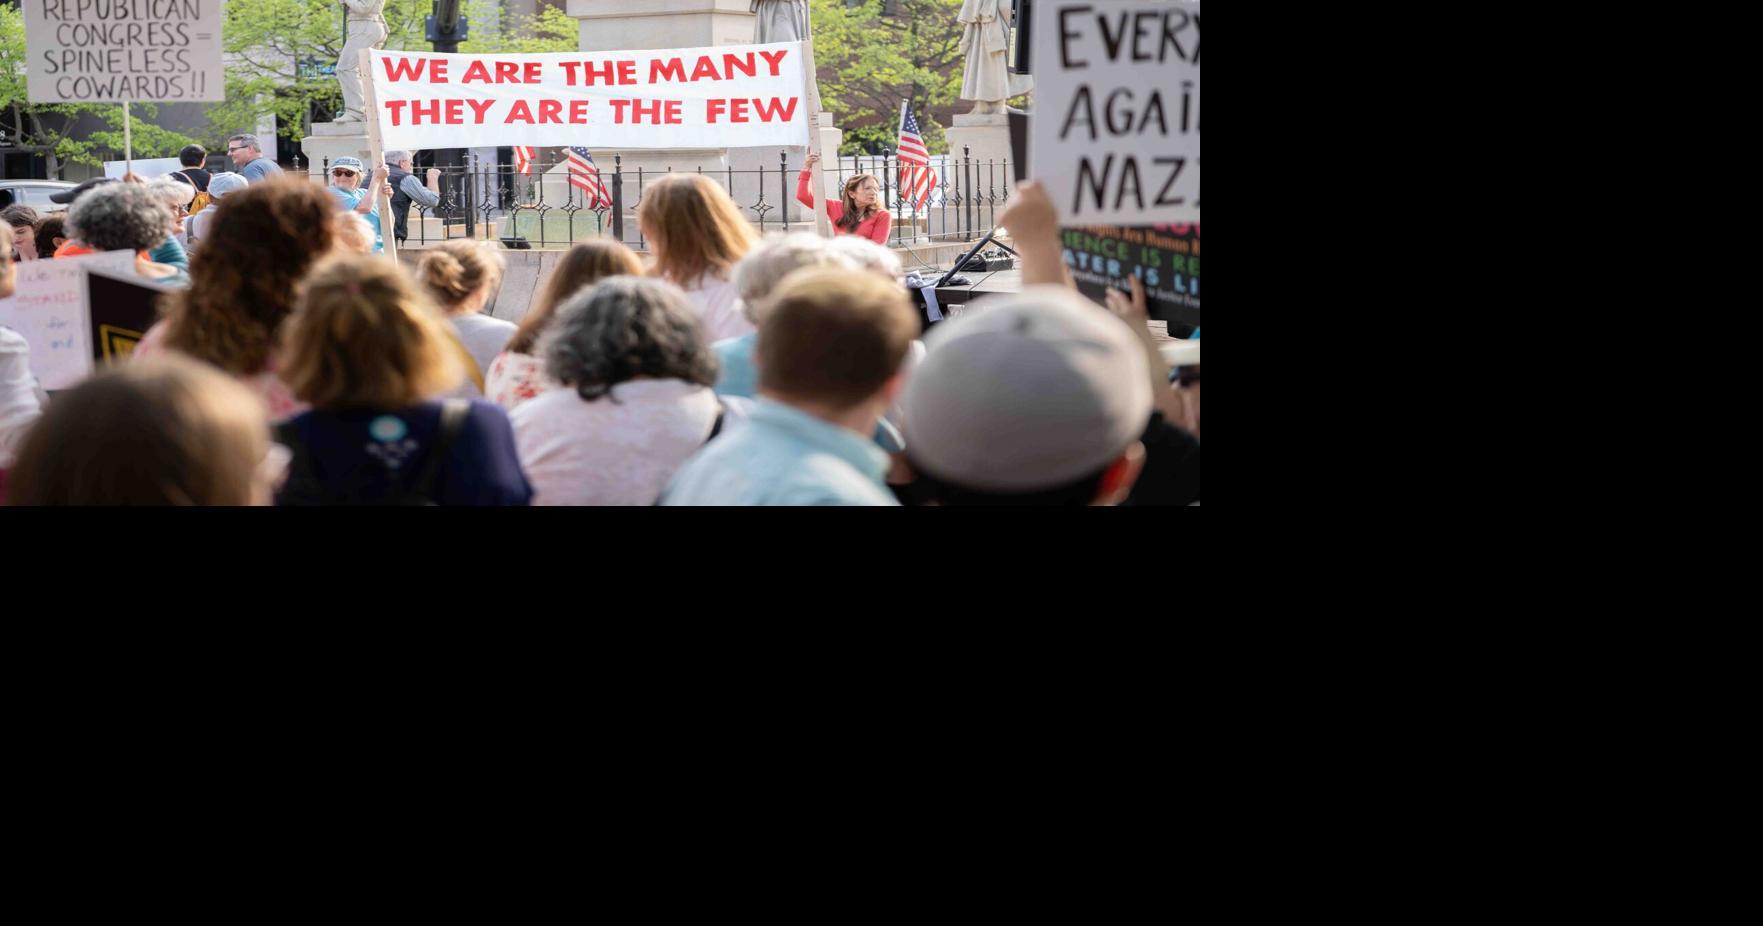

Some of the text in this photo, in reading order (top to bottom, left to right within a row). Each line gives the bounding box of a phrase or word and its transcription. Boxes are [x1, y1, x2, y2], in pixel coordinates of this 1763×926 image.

[43, 0, 200, 21] REPUBLICAN
[56, 22, 190, 47] CONGRESS
[43, 49, 191, 74] SPINELESS
[381, 50, 788, 86] WE ARE THE MANY
[56, 71, 205, 99] COWARDS!!
[385, 96, 799, 126] THEY ARE THE FEW
[1059, 80, 1200, 141] AGAI
[1072, 153, 1200, 215] NAZ
[1063, 230, 1200, 276] IENCE IS RE
[1063, 248, 1121, 277] ATER
[1135, 264, 1160, 286] IS
[1174, 273, 1199, 296] LI
